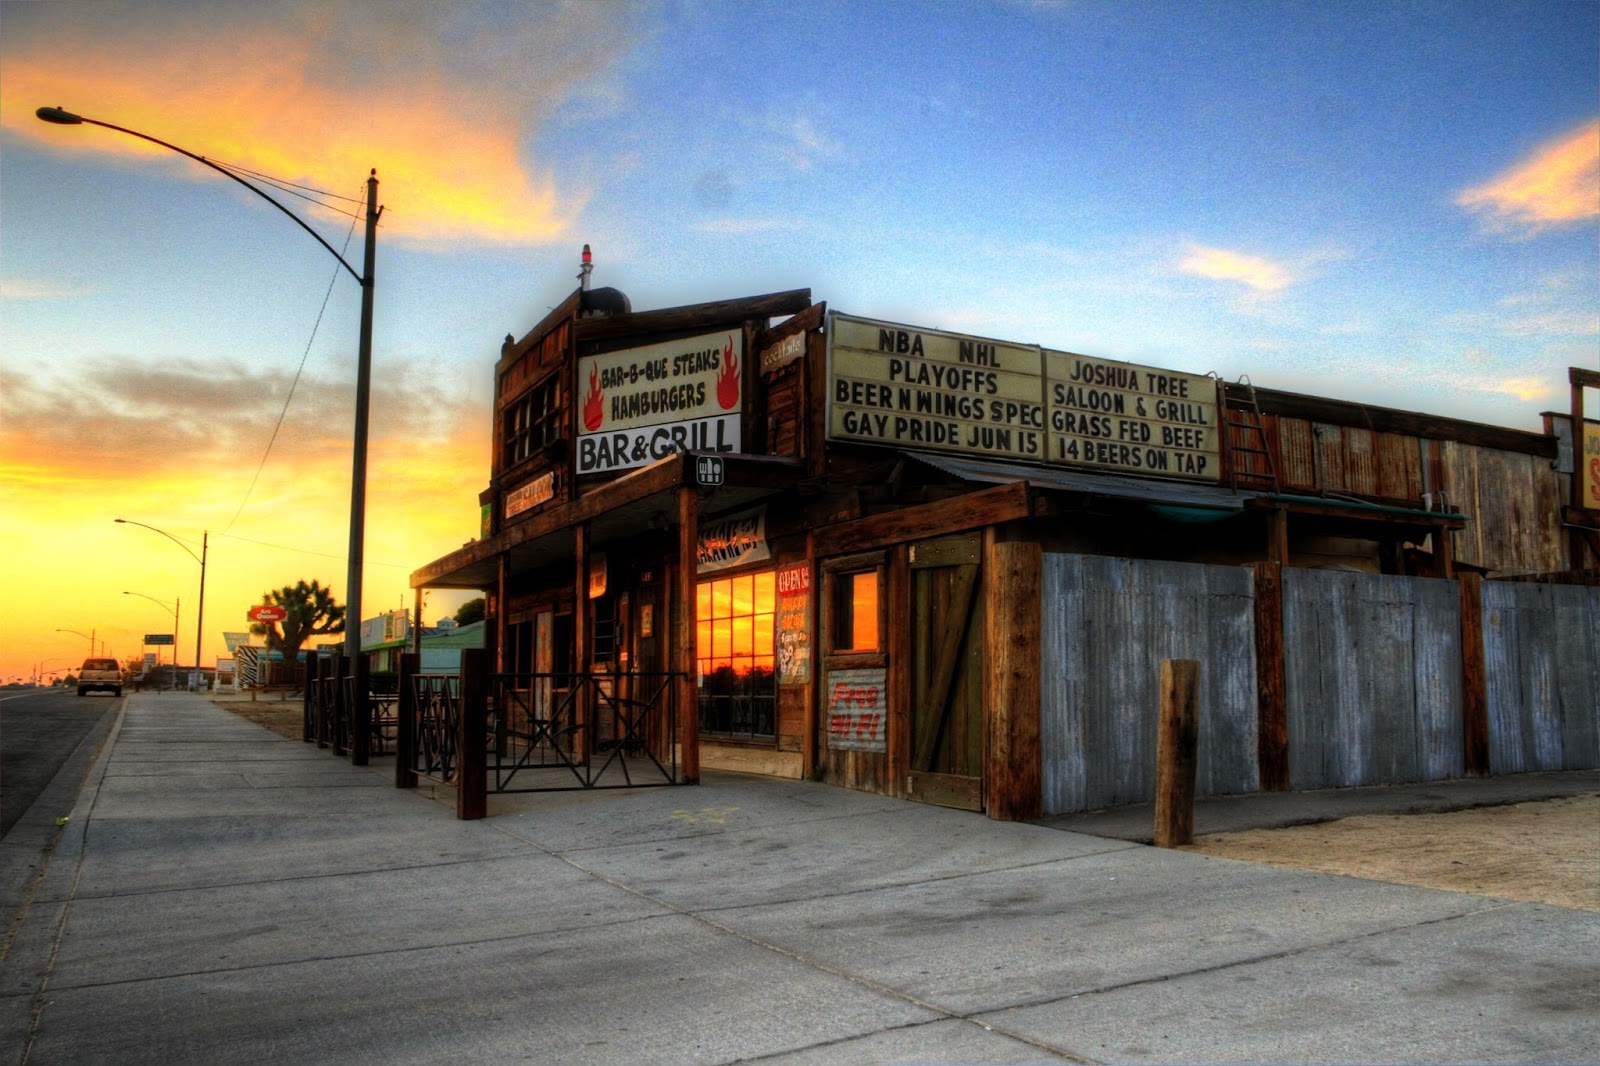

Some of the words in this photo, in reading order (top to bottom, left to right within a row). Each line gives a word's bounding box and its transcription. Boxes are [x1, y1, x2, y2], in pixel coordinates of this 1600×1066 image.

[879, 329, 924, 357] NBA
[959, 341, 1001, 367] NHL
[602, 358, 668, 389] BAR-B-QUE
[673, 349, 720, 377] STEAKS
[889, 359, 998, 394] PLAYOFFS
[1070, 360, 1139, 391] JOSHUA
[1146, 373, 1188, 398] TREE
[611, 382, 705, 421] HAMBURGERS
[836, 379, 893, 408] BEER
[899, 388, 911, 411] N
[917, 390, 984, 420] WINGS
[990, 401, 1042, 427] SPEC
[1053, 384, 1125, 414] SALOON
[1136, 397, 1147, 417] &
[1156, 399, 1207, 425] GRILL
[843, 411, 889, 437] GAY
[895, 417, 959, 445] PRIDE
[967, 426, 1011, 451] JUN
[1018, 431, 1038, 453] 15
[1052, 410, 1112, 438] GRASS
[1119, 420, 1151, 442] FED
[1162, 426, 1204, 449] BEEF
[1059, 437, 1079, 460] 14
[1084, 440, 1142, 467] BEERS
[1146, 449, 1168, 470] ON
[1174, 453, 1207, 474] TAP
[779, 568, 801, 592] OPEN
[831, 682, 880, 708] Free
